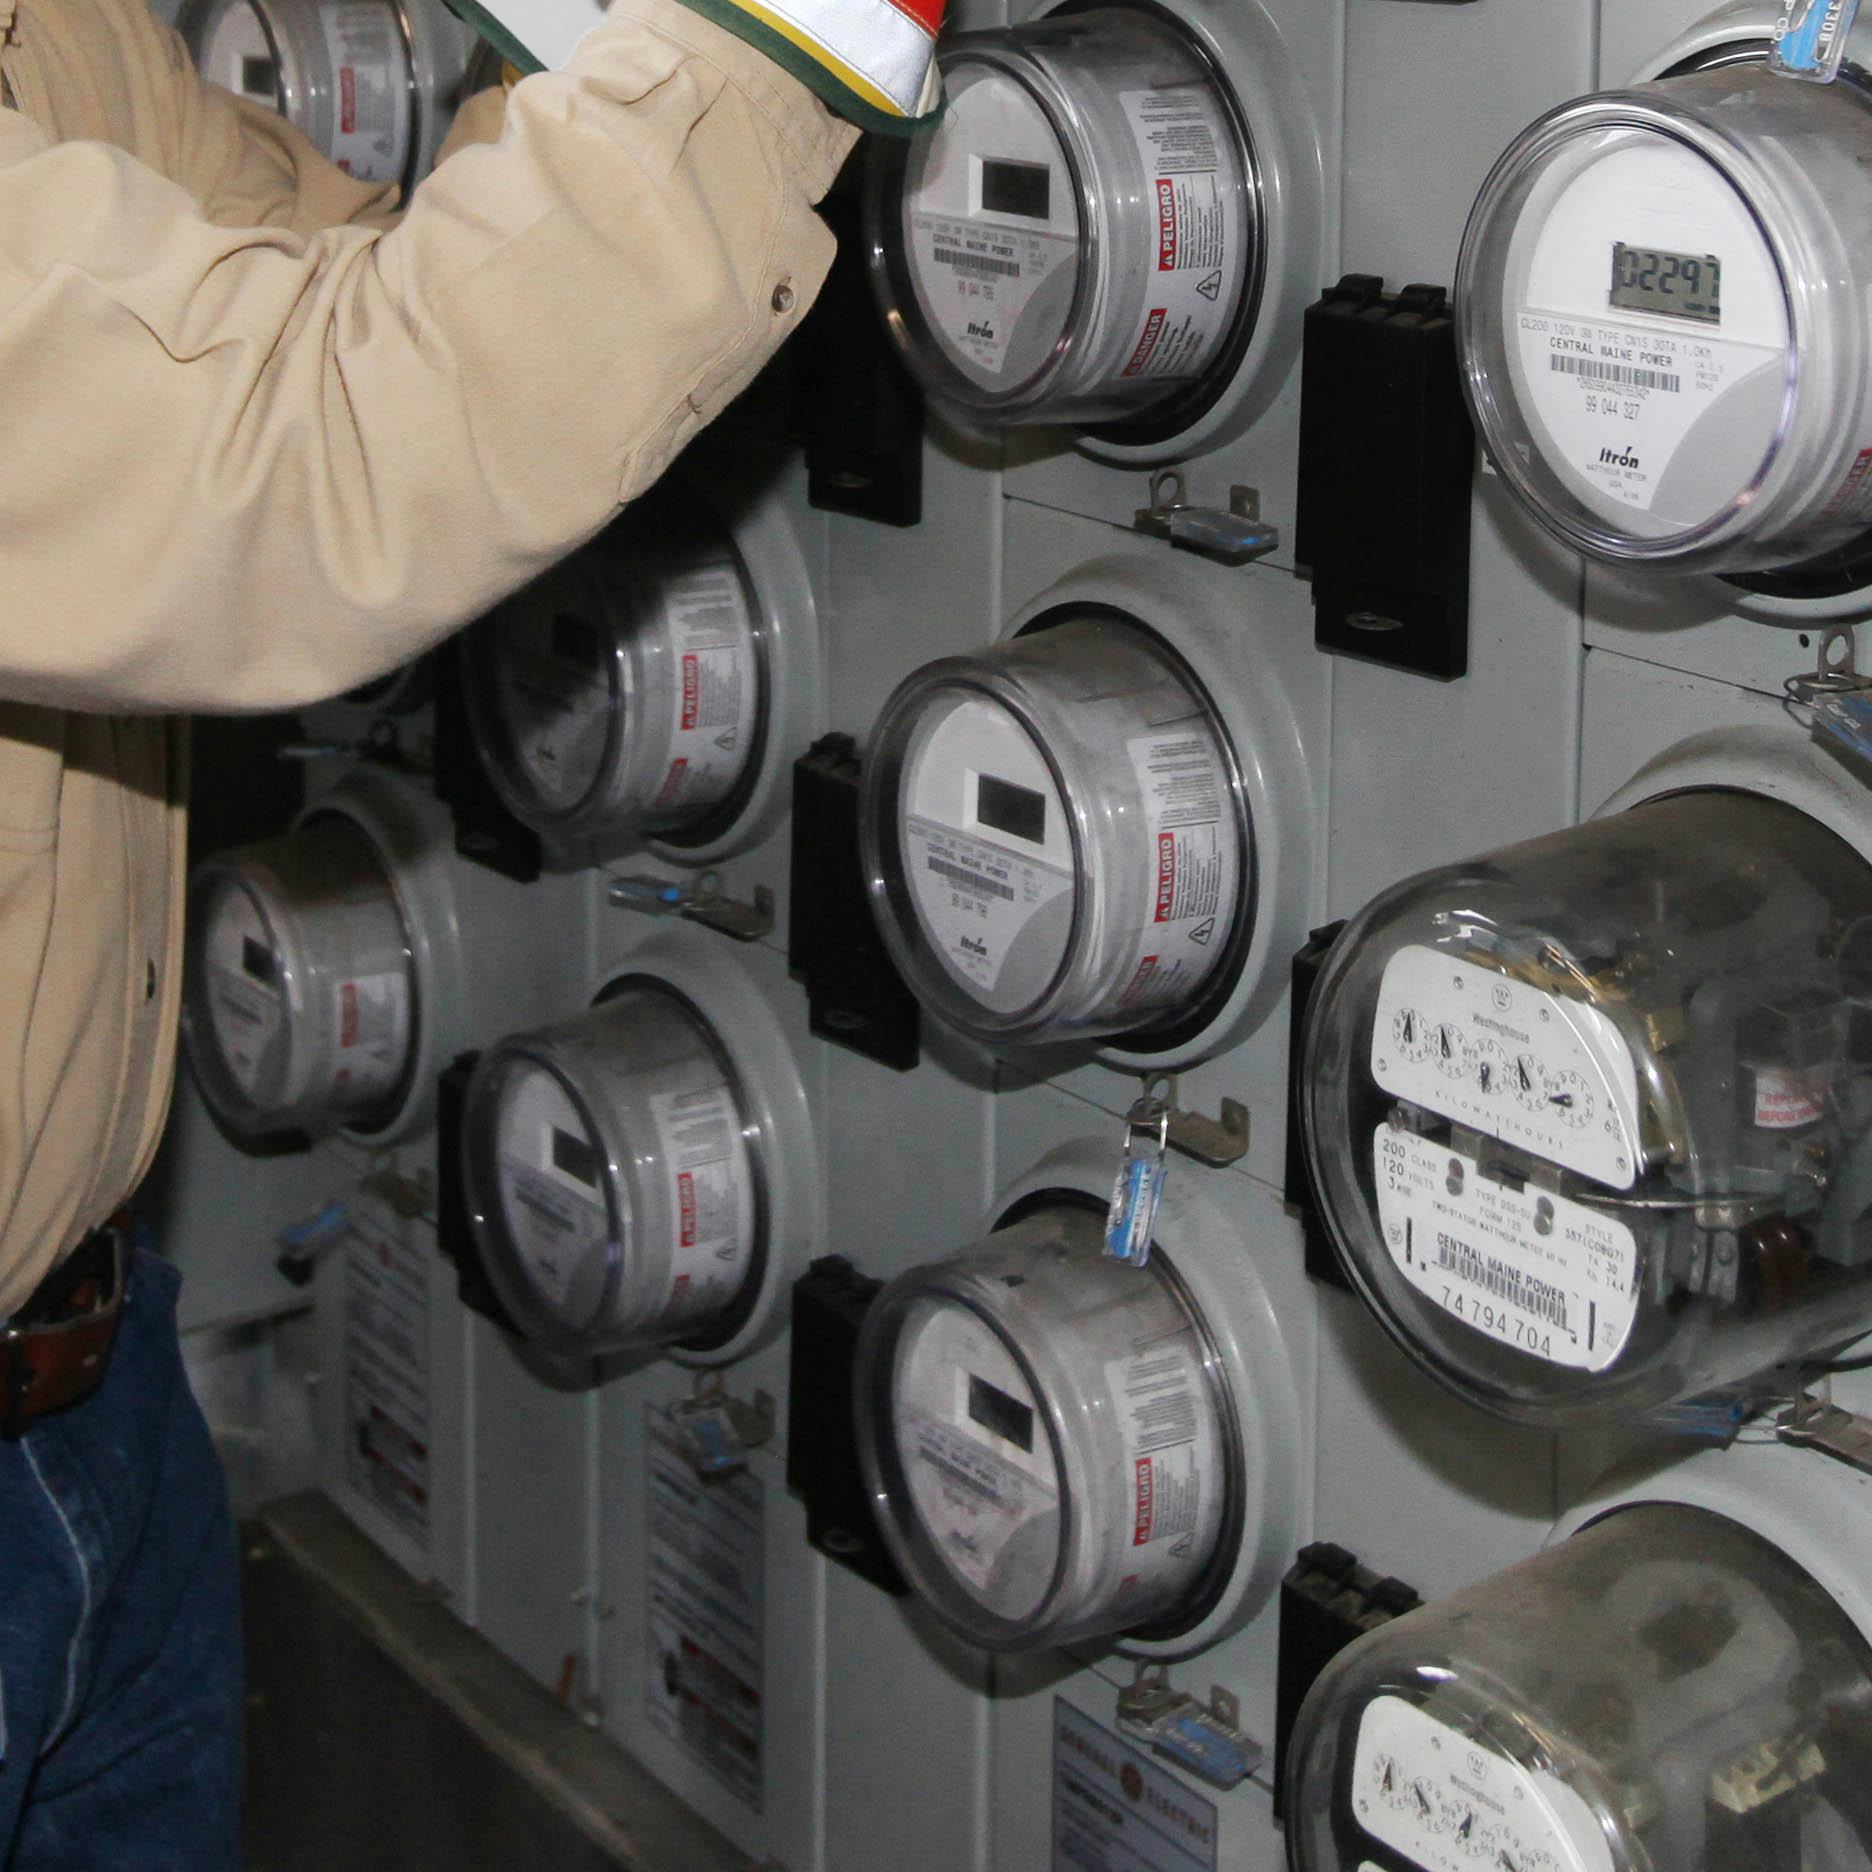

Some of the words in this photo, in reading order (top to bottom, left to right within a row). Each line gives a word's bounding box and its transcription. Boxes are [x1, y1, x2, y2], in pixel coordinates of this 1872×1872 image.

[1162, 183, 1177, 252] PELIGRO
[932, 233, 961, 247] CENTRAL
[991, 244, 1014, 257] POWER
[1619, 248, 1721, 299] 02297
[967, 320, 994, 339] Itron
[1133, 314, 1161, 369] DANGER
[1597, 329, 1621, 344] TYPE
[1549, 336, 1595, 356] CENTRAL
[1600, 344, 1633, 362] MAINE
[1639, 351, 1673, 368] POWER
[1585, 395, 1598, 413] 99
[1601, 398, 1619, 416] 044
[1599, 446, 1640, 470] Itron
[1159, 837, 1173, 905] PELIGRO
[1472, 1012, 1531, 1044] Westinghouse
[1382, 1138, 1407, 1159] 200
[1410, 1153, 1438, 1173] CLASS
[1382, 1157, 1405, 1177] 120
[1386, 1176, 1396, 1191] 3
[1479, 1206, 1504, 1223] FORM
[1584, 1223, 1614, 1245] STYLE
[1437, 1231, 1483, 1265] CENTRAL
[1487, 1257, 1521, 1284] MAINE
[1526, 1271, 1566, 1304] POWER
[1441, 1286, 1464, 1309] 74
[1472, 1301, 1507, 1334] 794
[1514, 1319, 1551, 1356] 704
